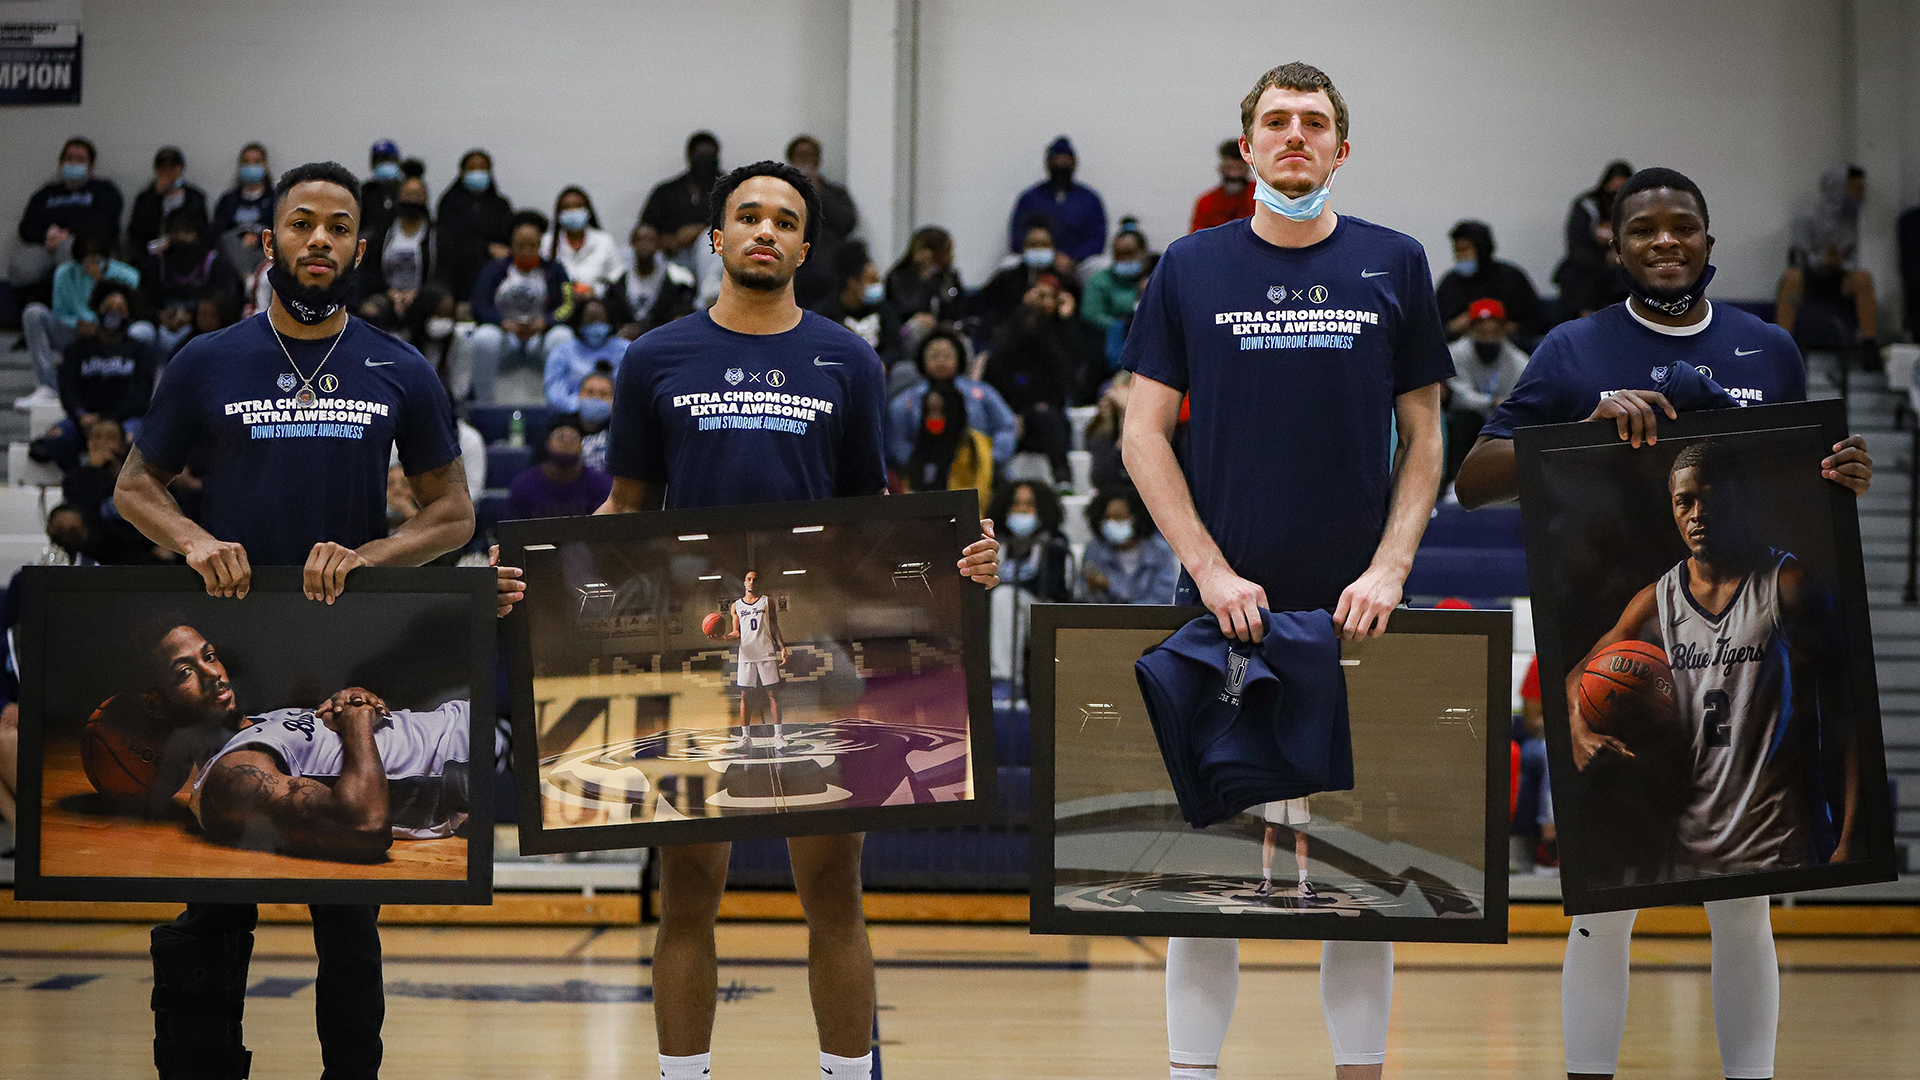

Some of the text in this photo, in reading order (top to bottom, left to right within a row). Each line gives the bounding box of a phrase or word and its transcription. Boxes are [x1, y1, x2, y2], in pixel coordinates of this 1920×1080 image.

[1215, 309, 1379, 325] EXTRA CHROMOSOME
[1232, 321, 1362, 335] EXTRA AWESOME
[1240, 334, 1354, 351] DOWN SYNDROME AWARENESS
[224, 397, 389, 417] EXTRA CHOMOSOME
[673, 391, 834, 414] EXTRA CHROMOSOME
[690, 402, 816, 421] EXTRA AWESOME
[242, 409, 373, 425] EXTRA AWESOME
[698, 416, 808, 436] DOWN SYNDROME AWARENESS
[251, 423, 364, 440] DOWN SYNDROME AWARENESS
[750, 618, 758, 631] 0
[1670, 636, 1764, 677] Blue Tigers
[1703, 688, 1732, 747] 2
